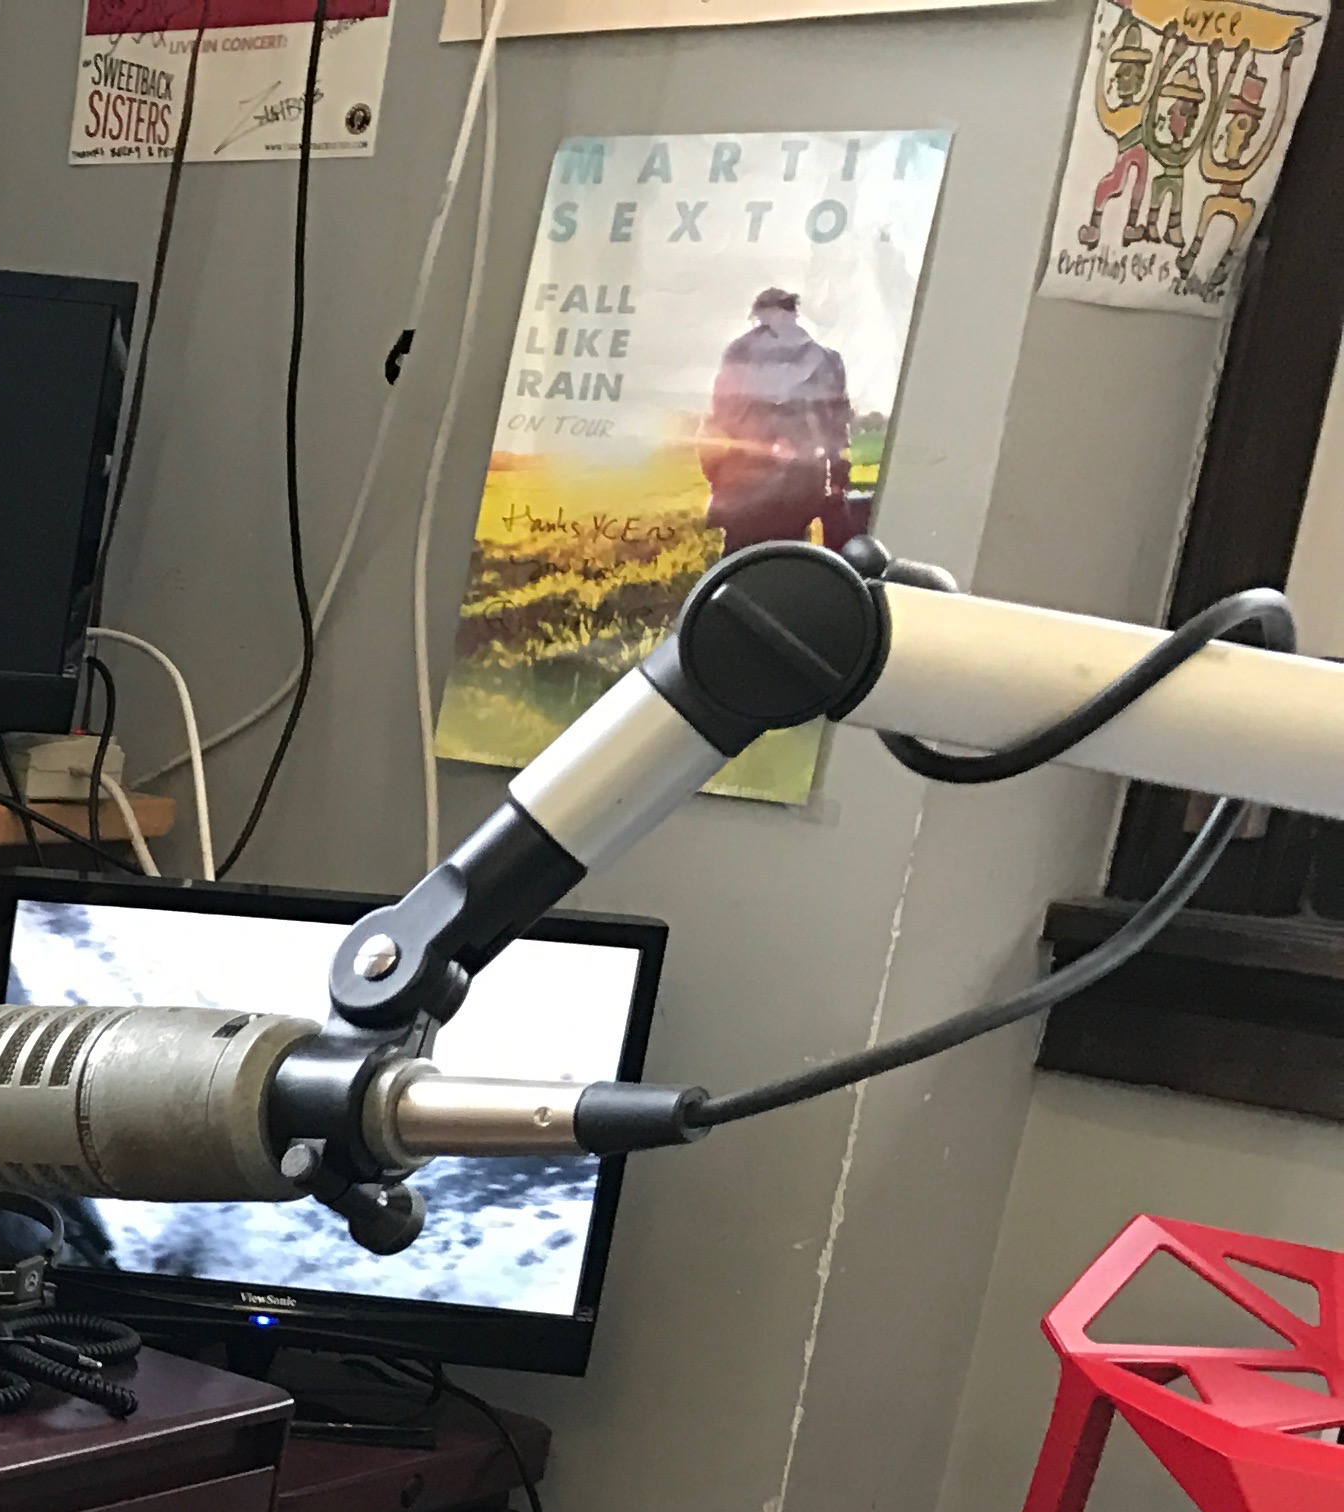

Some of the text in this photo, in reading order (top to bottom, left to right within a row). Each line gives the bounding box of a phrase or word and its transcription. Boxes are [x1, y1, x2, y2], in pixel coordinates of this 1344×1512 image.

[169, 39, 198, 54] LIV
[91, 53, 174, 101] SWEETBACK
[85, 90, 171, 145] SISTERS
[547, 198, 892, 244] SEXTO
[534, 283, 636, 314] FALL
[524, 327, 631, 358] LIKE
[516, 369, 624, 402] RAIN
[507, 413, 616, 438] ON TOUR
[240, 1292, 298, 1308] ViewSonic
